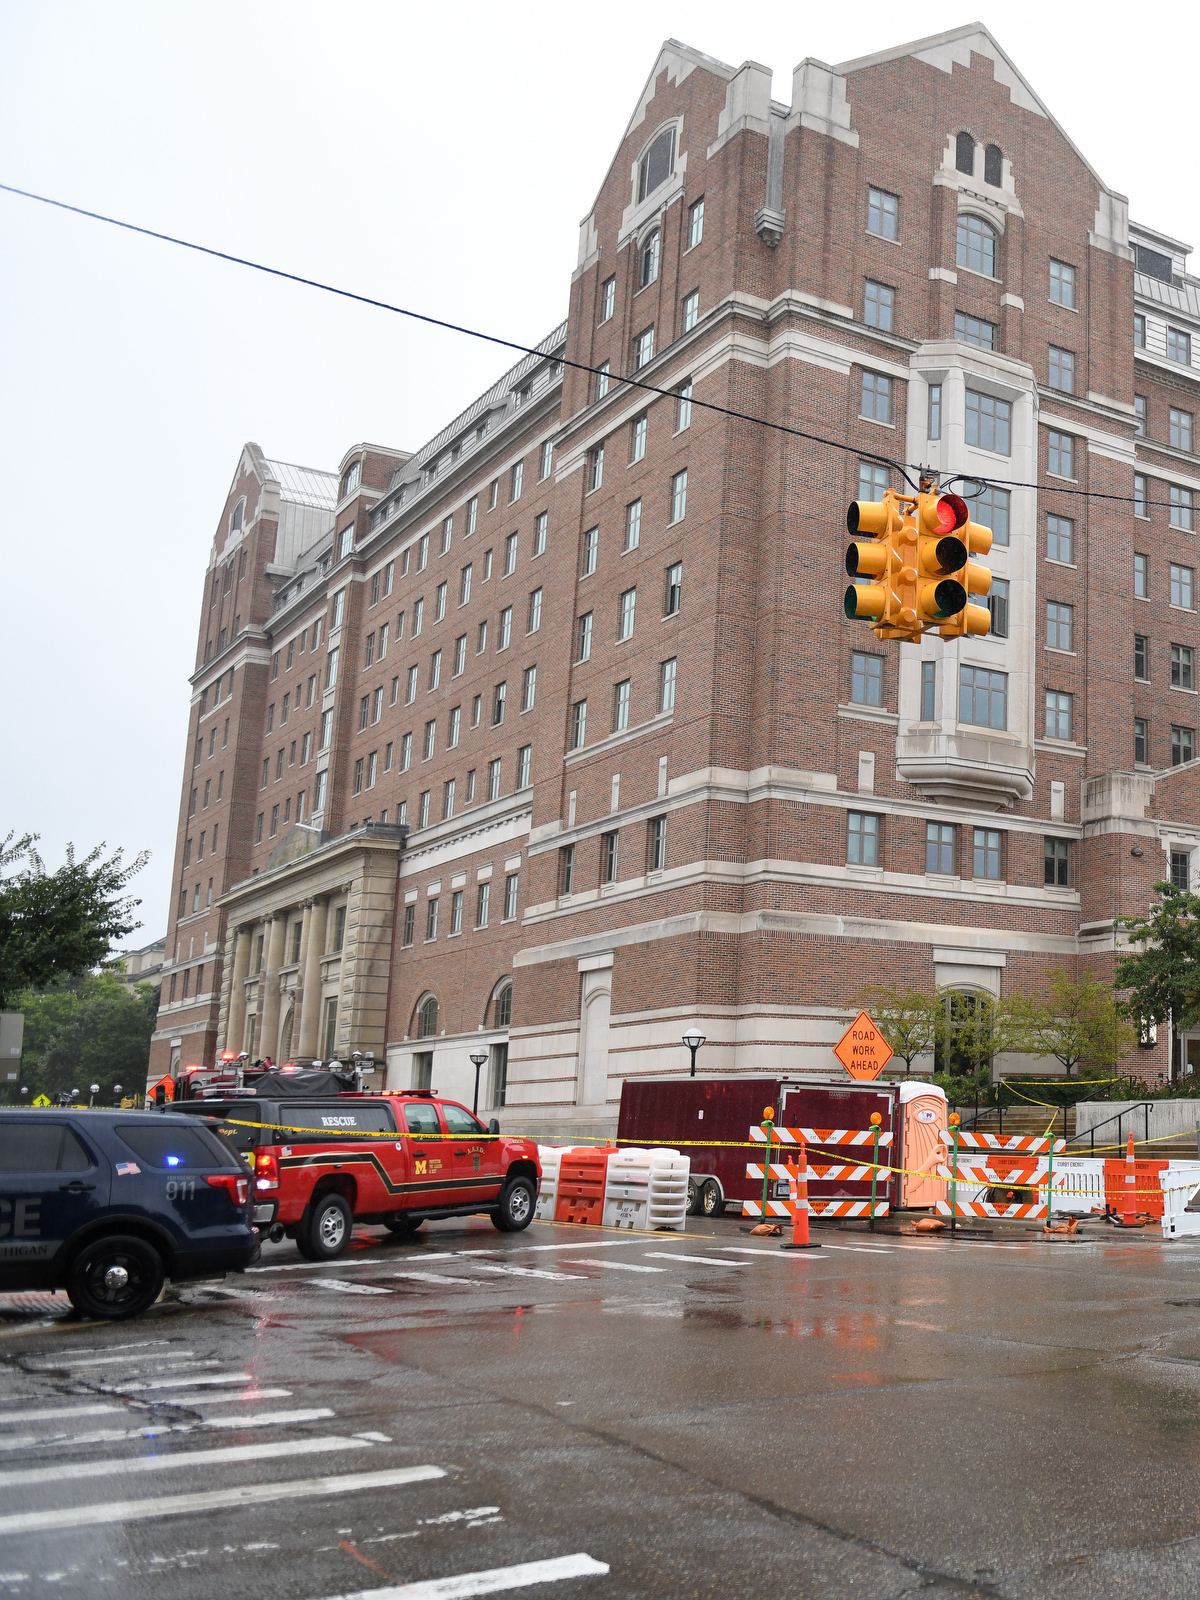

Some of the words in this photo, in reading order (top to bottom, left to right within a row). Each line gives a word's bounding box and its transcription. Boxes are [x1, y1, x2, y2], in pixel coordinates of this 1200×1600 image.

[852, 1031, 875, 1040] ROAD
[852, 1046, 875, 1055] WORK
[850, 1061, 878, 1070] AHEAD
[321, 1116, 357, 1127] RESCUE
[415, 1160, 427, 1175] M
[166, 1181, 196, 1201] 911
